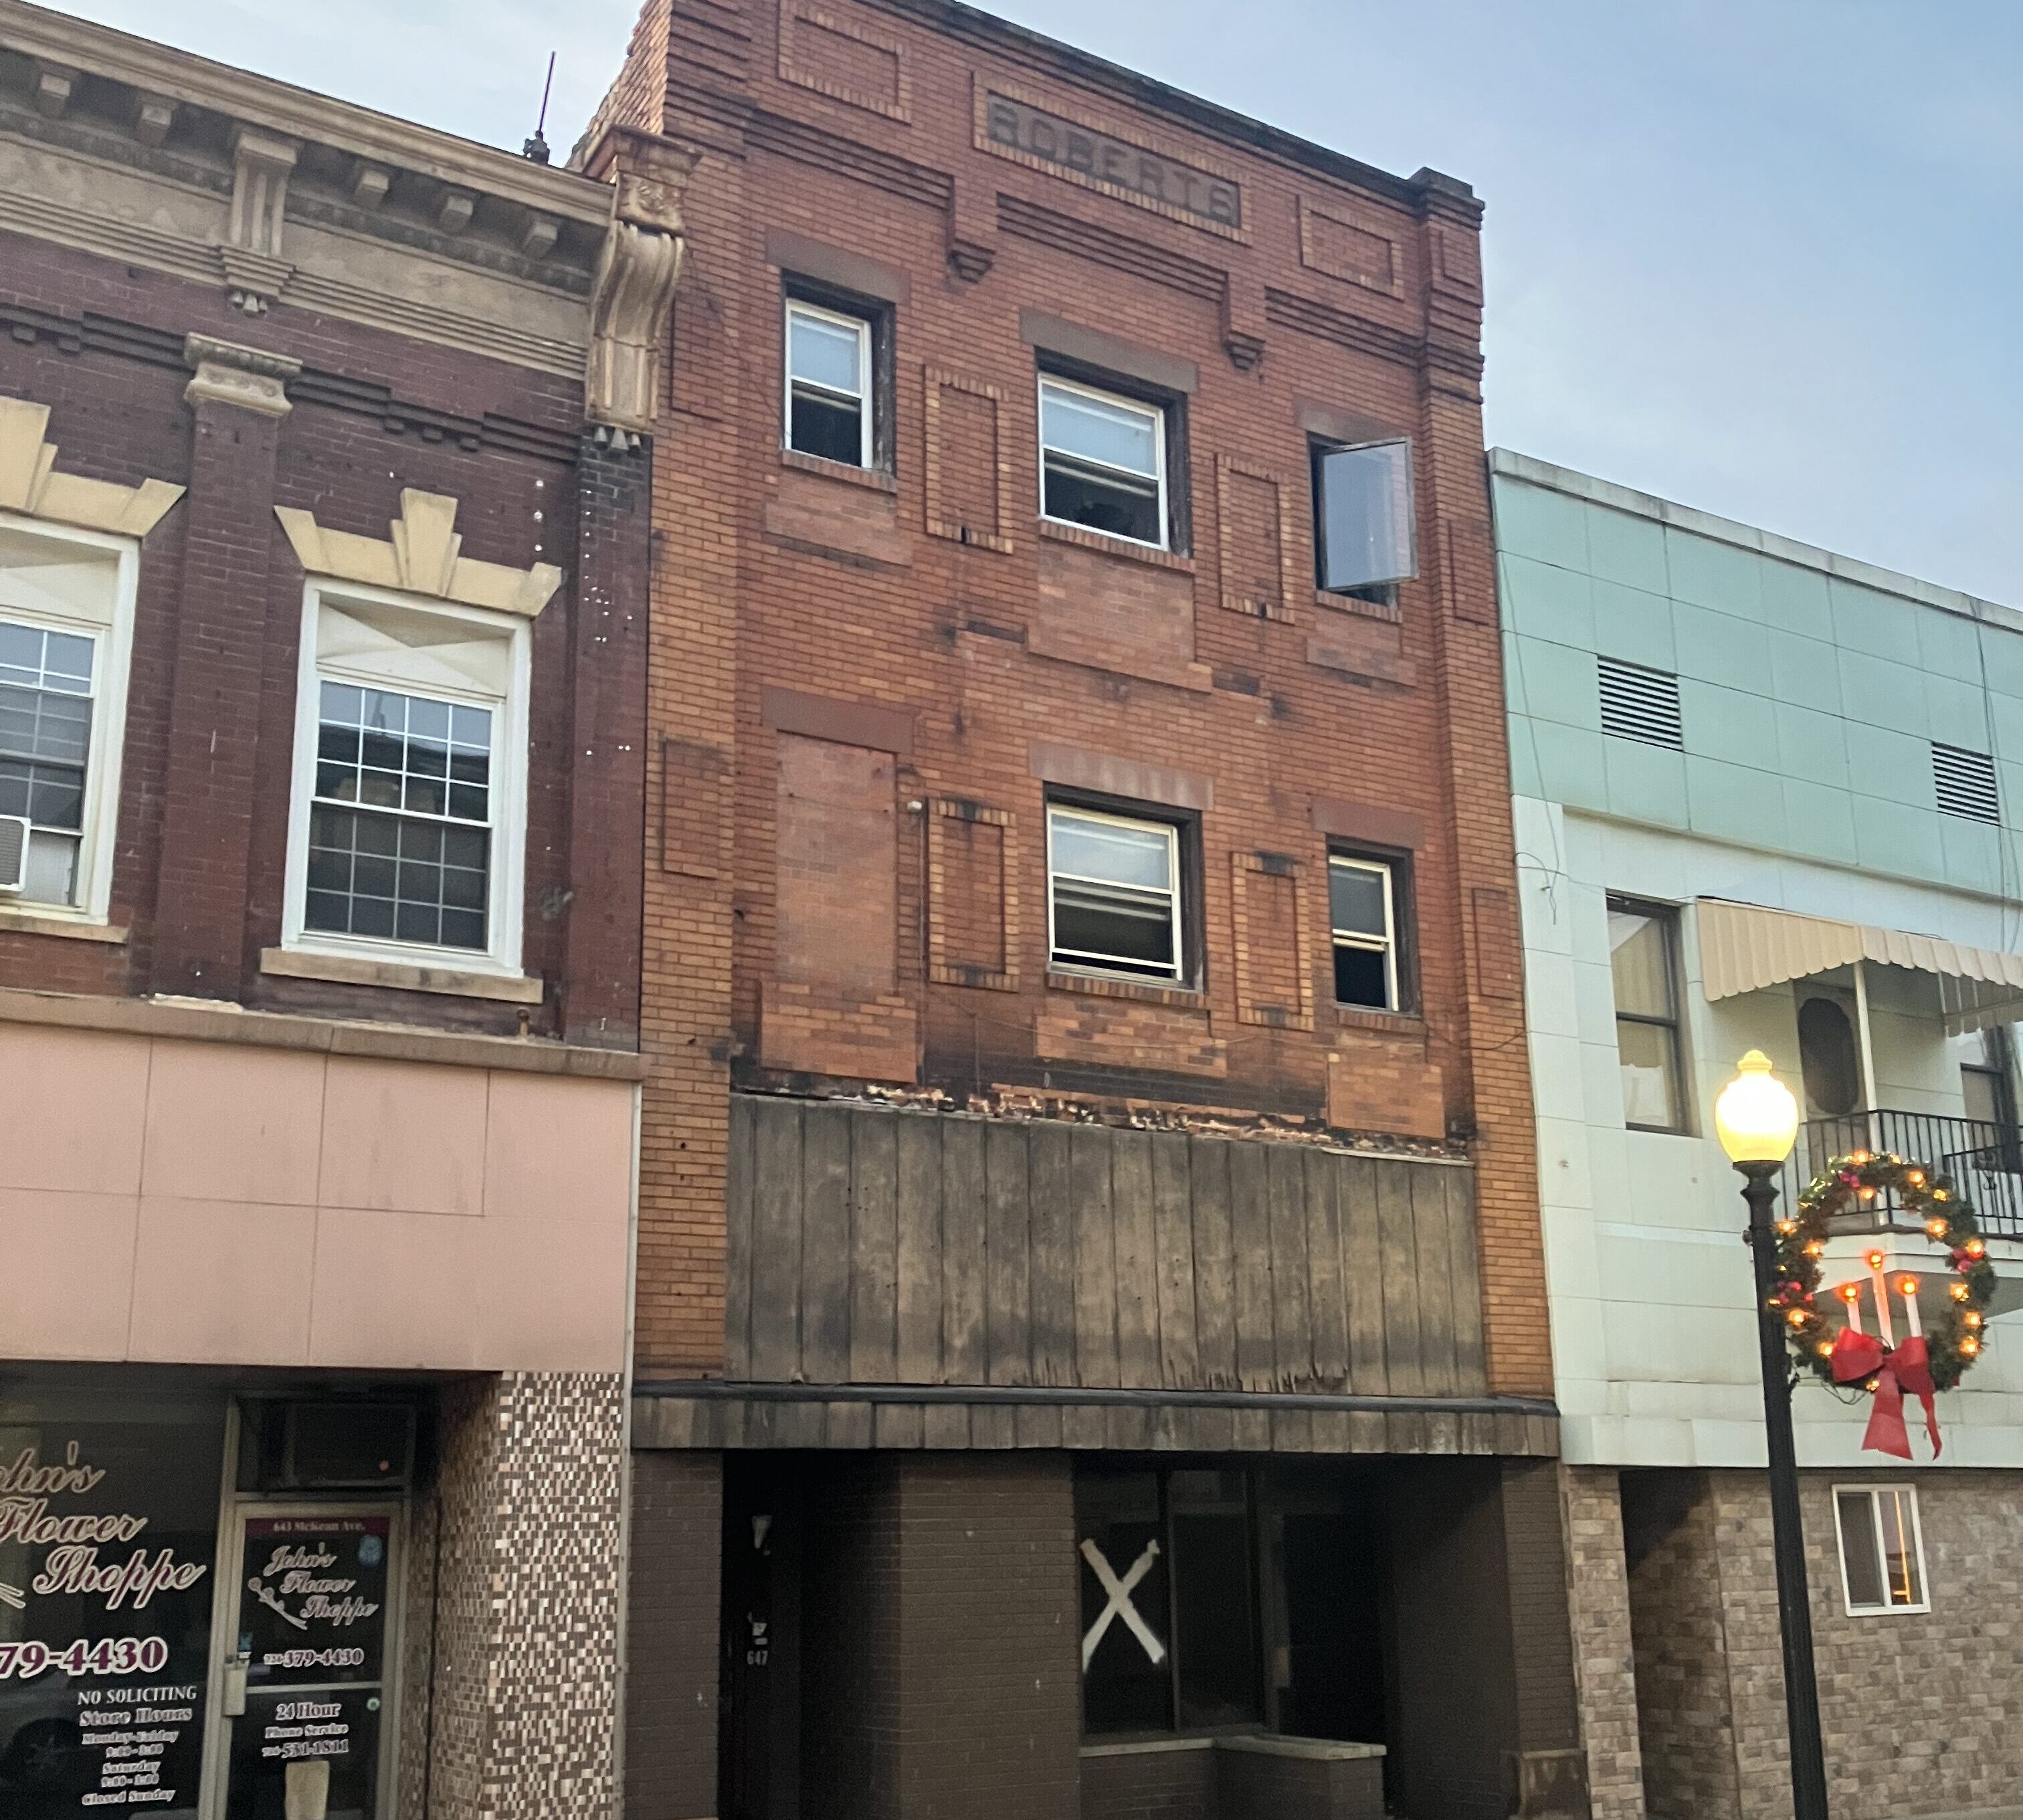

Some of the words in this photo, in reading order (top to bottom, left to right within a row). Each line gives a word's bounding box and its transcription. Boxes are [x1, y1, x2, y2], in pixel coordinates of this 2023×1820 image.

[987, 99, 1240, 229] ROBERTS
[263, 1542, 338, 1577] John's
[33, 1545, 207, 1610] Shoppe
[279, 1570, 357, 1594] Flower
[300, 1595, 379, 1626] Shoppe
[78, 1690, 102, 1706] NO
[106, 1686, 197, 1704] SOLICITING
[79, 1710, 131, 1727] Store
[134, 1708, 193, 1724] Hours
[276, 1703, 296, 1720] 24
[296, 1702, 342, 1720] Hour
[265, 1726, 303, 1739] Phone
[304, 1722, 349, 1736] Service
[82, 1790, 127, 1806] Closed
[128, 1788, 177, 1803] Sunday
